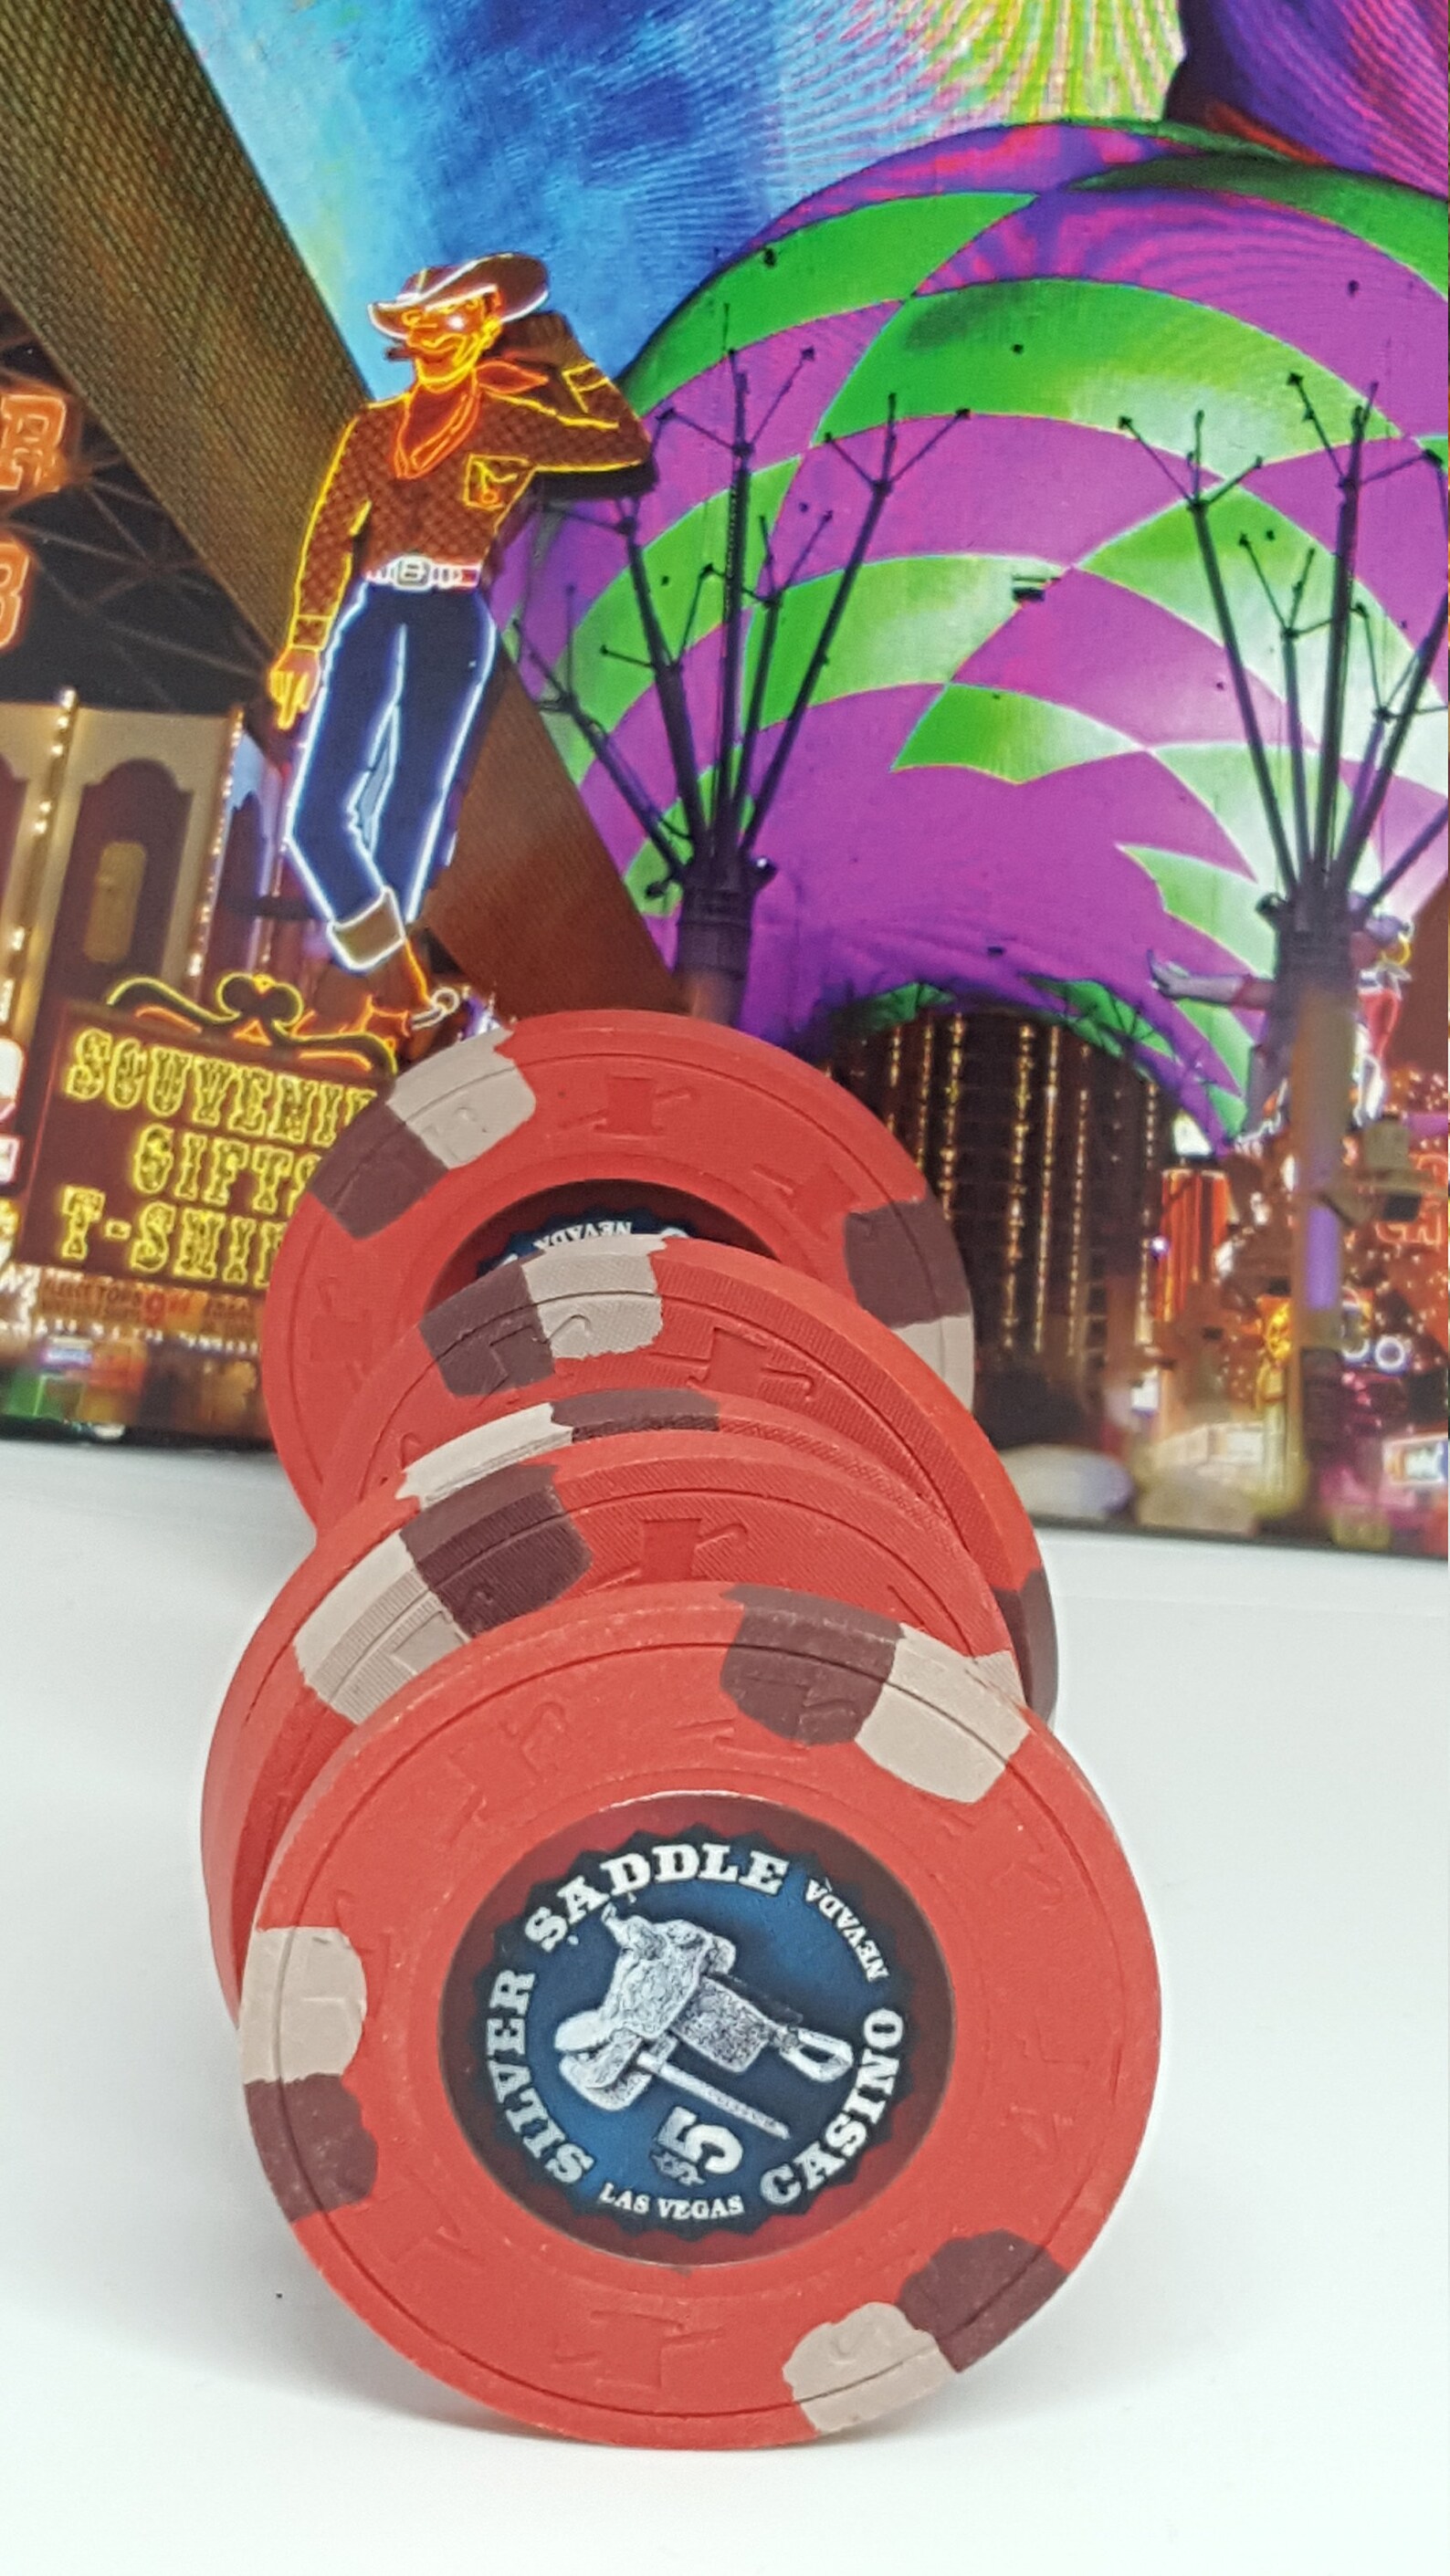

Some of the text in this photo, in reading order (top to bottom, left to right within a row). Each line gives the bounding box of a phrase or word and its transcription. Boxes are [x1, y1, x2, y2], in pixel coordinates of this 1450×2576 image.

[805, 1877, 890, 1982] NEVADA
[486, 1842, 790, 2184] SILVER SADDLE
[759, 2007, 905, 2205] CASINO
[599, 2182, 745, 2220] LAS VEGAS
